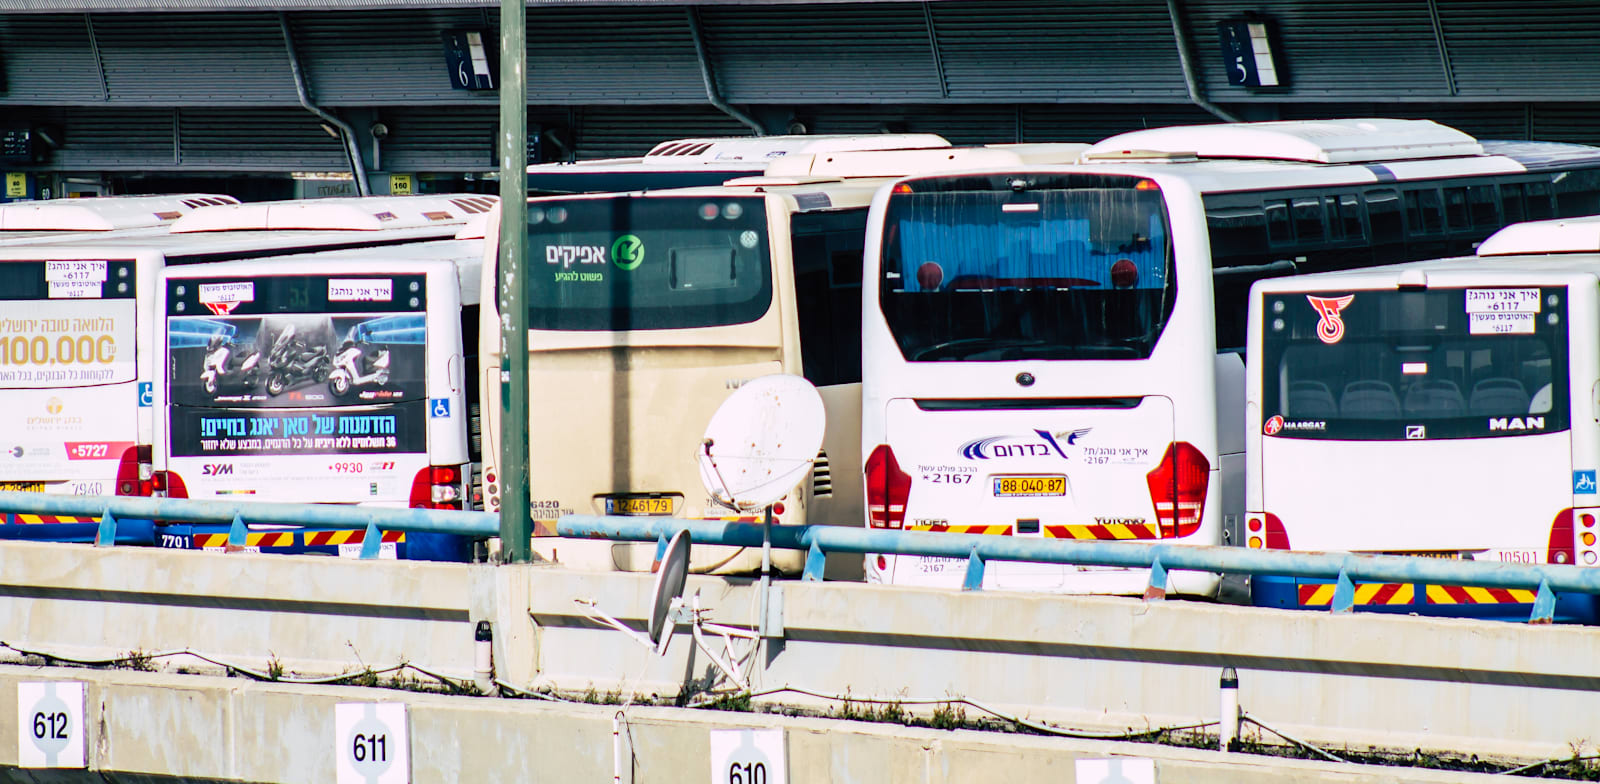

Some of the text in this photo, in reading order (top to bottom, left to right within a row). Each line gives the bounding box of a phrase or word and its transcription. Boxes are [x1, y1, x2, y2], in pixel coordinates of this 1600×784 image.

[458, 60, 469, 87] 6
[1236, 56, 1247, 83] 5
[394, 182, 408, 190] 160
[546, 245, 606, 268] אפיקים
[73, 263, 87, 271] אני
[90, 263, 105, 272] איך
[555, 271, 603, 282] פשוט להגיע
[356, 288, 371, 296] אני
[374, 288, 390, 297] איך
[1500, 290, 1516, 300] אני
[1520, 290, 1538, 301] איך
[41, 319, 70, 333] טובה
[73, 317, 114, 333] הלוואה
[81, 368, 114, 381] ללקוחות
[200, 413, 395, 438] הזדמנות של סאן יאנג בחיים!
[1283, 421, 1326, 430] HAARGAZ
[1489, 417, 1545, 430] MAN
[219, 438, 236, 450] שלא
[993, 443, 1051, 457] בדרום
[1119, 448, 1131, 456] אני
[1133, 448, 1148, 458] איך
[202, 463, 233, 476] SYM
[531, 500, 560, 509] 6420
[161, 535, 190, 549] 7701
[1498, 550, 1538, 565] 10501
[33, 711, 68, 739] 612
[353, 733, 386, 762] 611
[730, 761, 767, 784] 610
